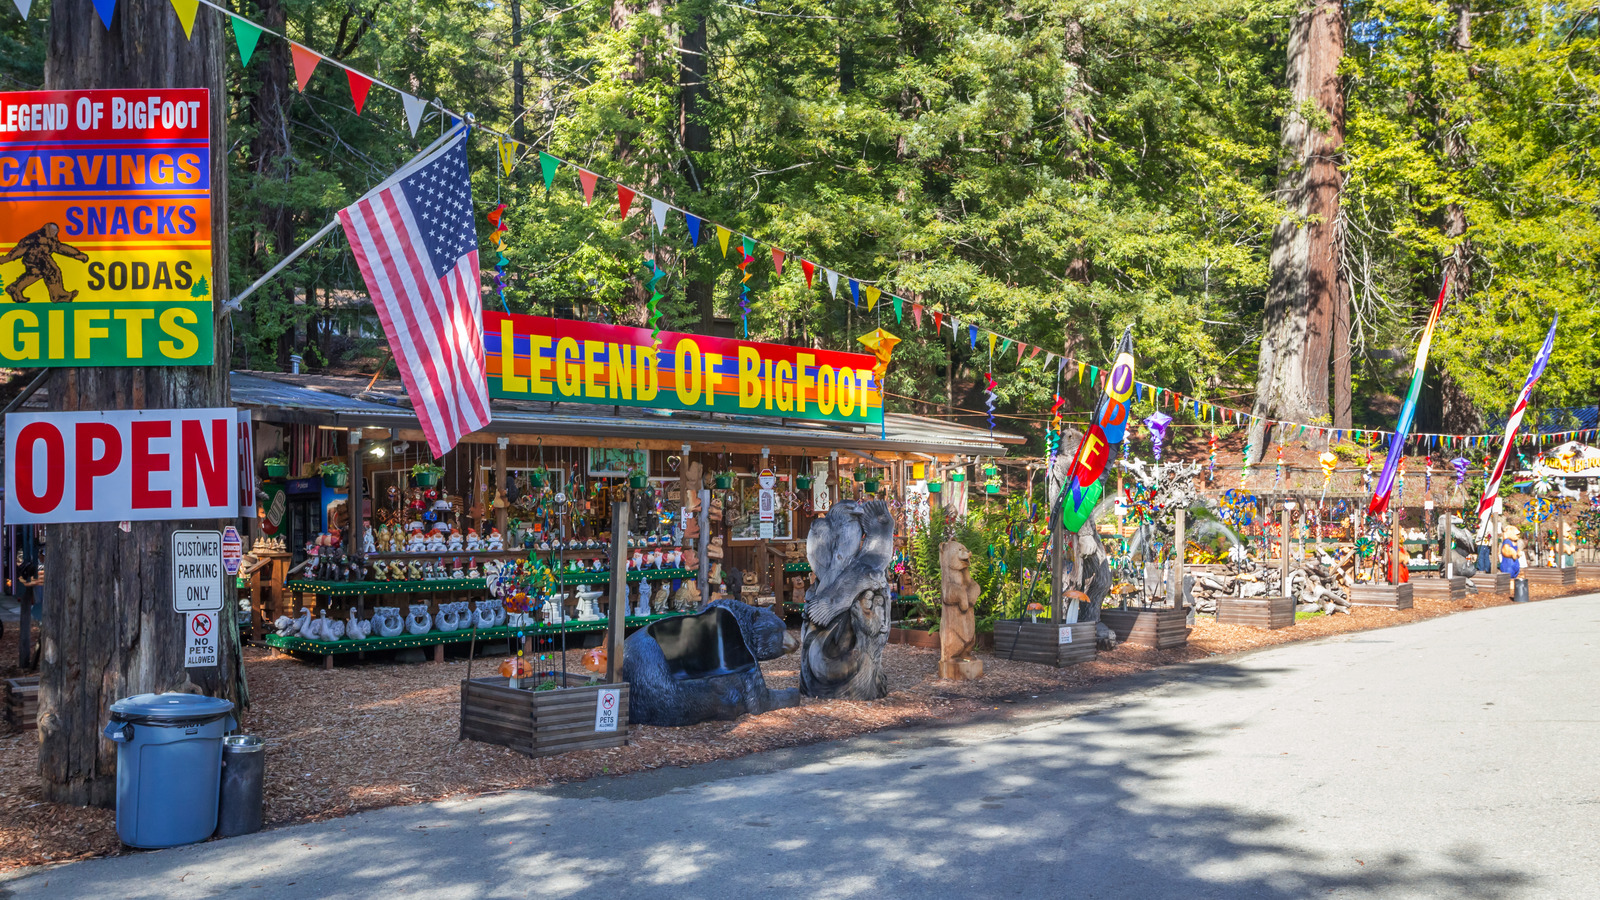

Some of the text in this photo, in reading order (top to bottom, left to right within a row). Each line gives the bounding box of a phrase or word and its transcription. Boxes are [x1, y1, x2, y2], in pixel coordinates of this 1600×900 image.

[0, 153, 201, 187] CARVINGS
[65, 204, 197, 236] SNACKS
[87, 260, 193, 291] SODAS
[0, 307, 199, 360] GIFTS
[15, 419, 228, 514] OPEN
[176, 541, 219, 557] CUSTOMER
[178, 563, 218, 579] PARKING
[186, 586, 210, 601] ONLY
[194, 637, 209, 646] NO
[189, 645, 214, 655] PETS
[187, 655, 216, 665] ALLOWED
